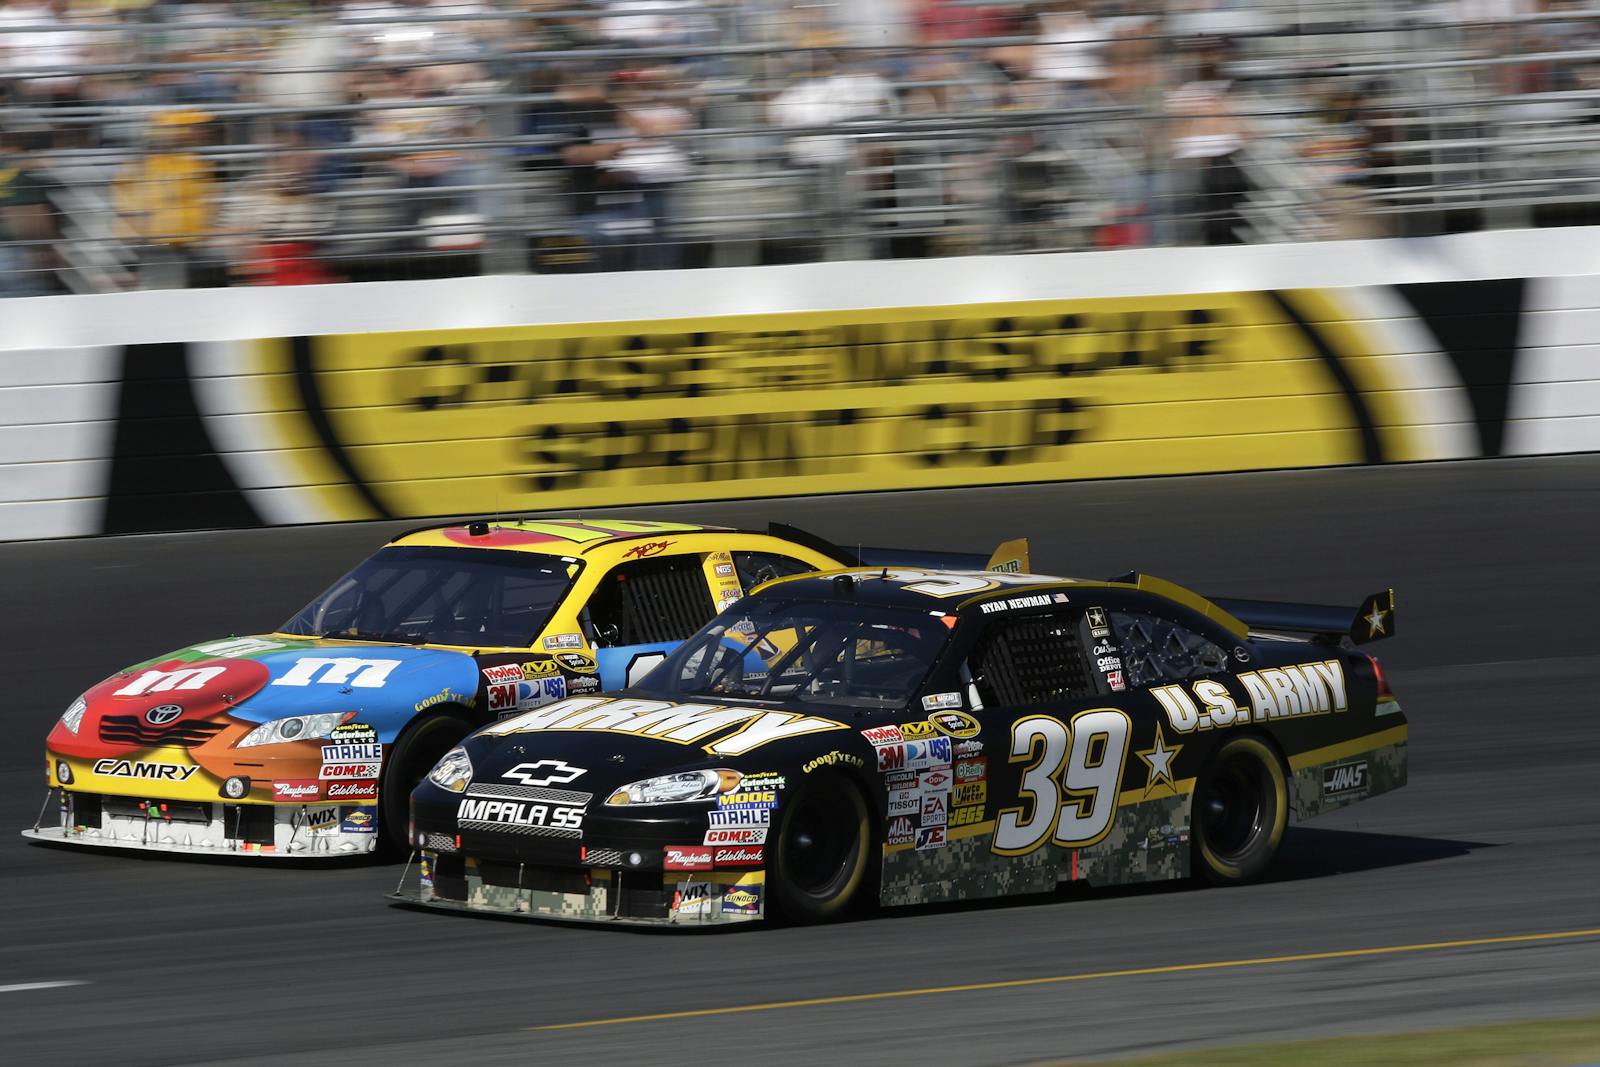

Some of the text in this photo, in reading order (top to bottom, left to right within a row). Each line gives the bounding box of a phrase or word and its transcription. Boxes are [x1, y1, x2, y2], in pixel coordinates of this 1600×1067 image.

[980, 595, 1052, 613] RYAN NEWMAN
[1097, 657, 1121, 666] Office
[1099, 664, 1122, 672] DEPOT
[112, 666, 227, 696] m
[271, 657, 402, 688] m
[486, 667, 522, 679] Holley
[490, 684, 516, 709] 3M
[544, 678, 564, 699] USG
[415, 687, 477, 712] GOODYEAR
[330, 730, 376, 741] Gatorback
[471, 697, 851, 757] ARMY
[864, 728, 902, 740] Holley
[324, 745, 381, 759] MAHLE
[879, 745, 904, 770] 3M
[929, 738, 951, 762] USG
[803, 750, 864, 773] GOODYEAR
[94, 760, 199, 781] CAMRY
[323, 765, 367, 776] COMP
[887, 773, 914, 782] LINCOLN
[740, 776, 786, 787] Gatorback
[991, 707, 1132, 857] 39
[273, 784, 376, 798] Raybestos Edelbrock
[720, 791, 775, 805] MOOG
[457, 799, 584, 828] IMPALA SS
[889, 800, 919, 810] TISSOT
[923, 797, 945, 814] EA
[308, 808, 336, 826] WIX
[711, 810, 769, 825] MAHLE
[923, 814, 946, 823] SPORTS
[948, 805, 985, 826] JEGS
[888, 818, 914, 837] MAC
[708, 831, 752, 842] COMP
[888, 836, 914, 846] TOOLS
[667, 849, 763, 866] Raybestos Edelbrock
